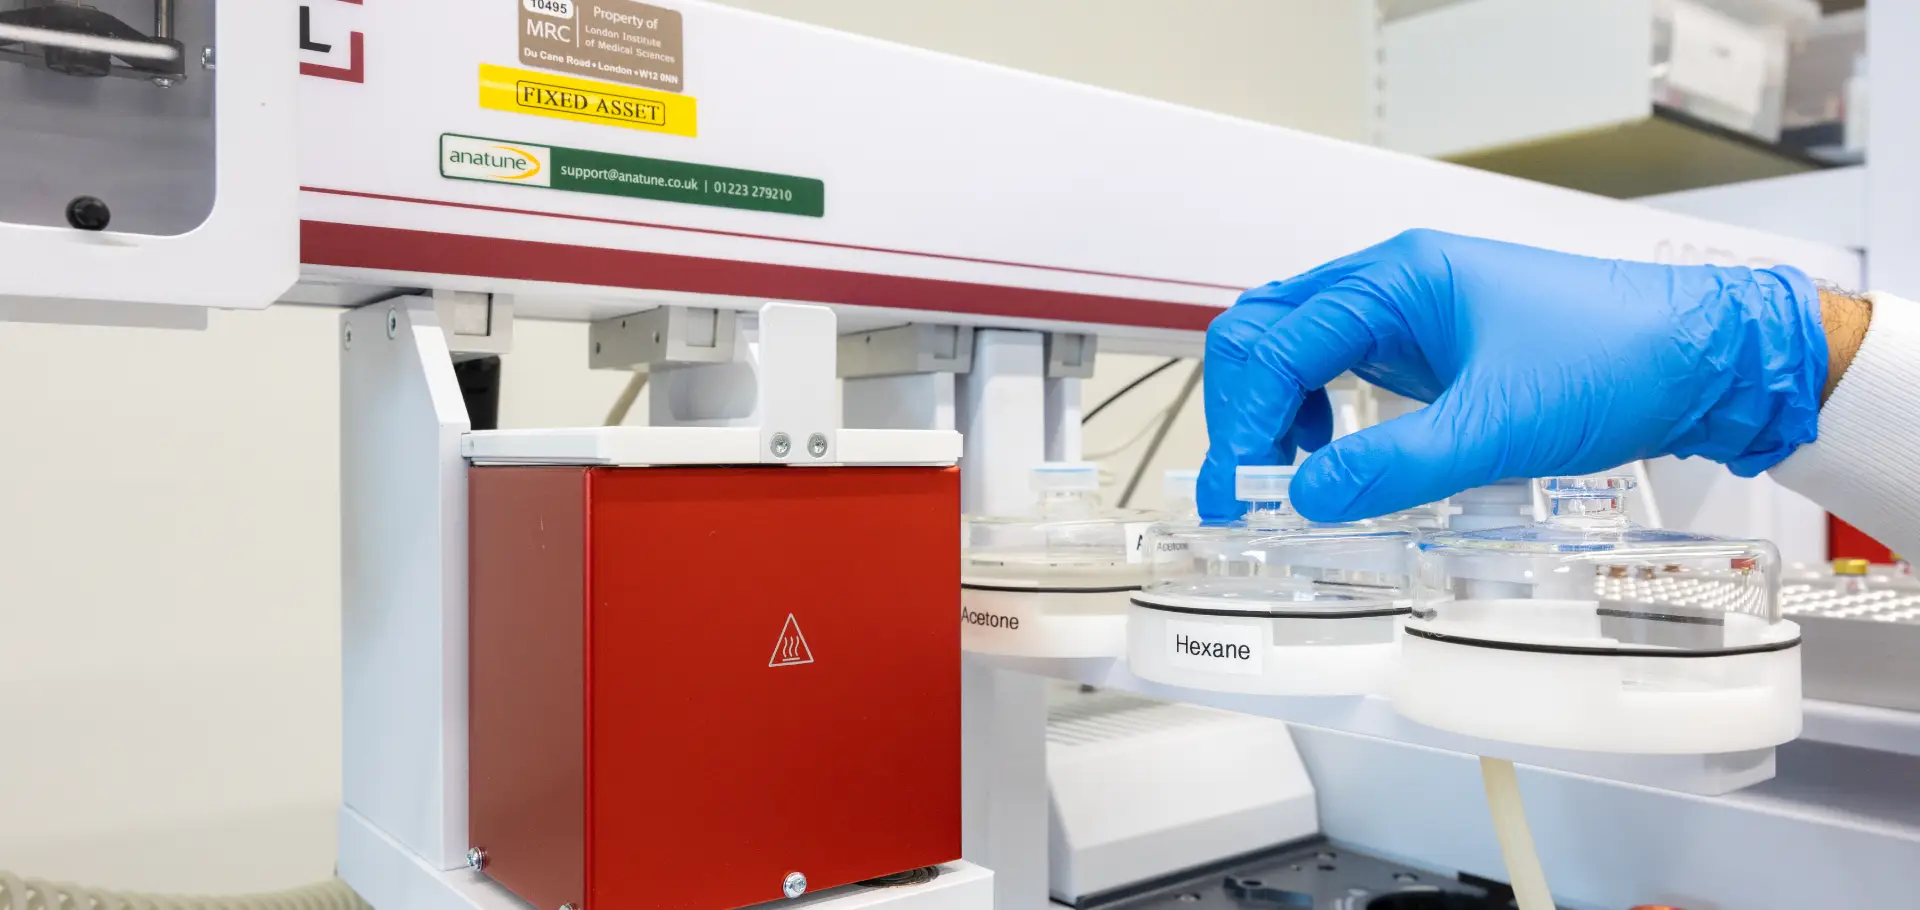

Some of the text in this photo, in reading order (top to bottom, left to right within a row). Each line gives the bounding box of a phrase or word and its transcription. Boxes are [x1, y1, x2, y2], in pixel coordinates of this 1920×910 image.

[532, 0, 567, 14] 10495
[593, 6, 659, 30] Property of
[526, 18, 571, 43] MRC
[585, 25, 662, 48] London Institute
[585, 38, 675, 63] of Medical Sciences
[524, 47, 538, 58] Du
[540, 51, 565, 63] Cane
[566, 55, 591, 68] Road
[598, 62, 633, 76] London
[639, 69, 659, 81] W12
[523, 86, 660, 121] FIXED ASSET
[449, 150, 527, 170] anatune
[560, 165, 793, 202] support@anatune.co.uk 01223 279210
[961, 606, 1019, 630] Acetone
[1175, 634, 1251, 660] Hexane
